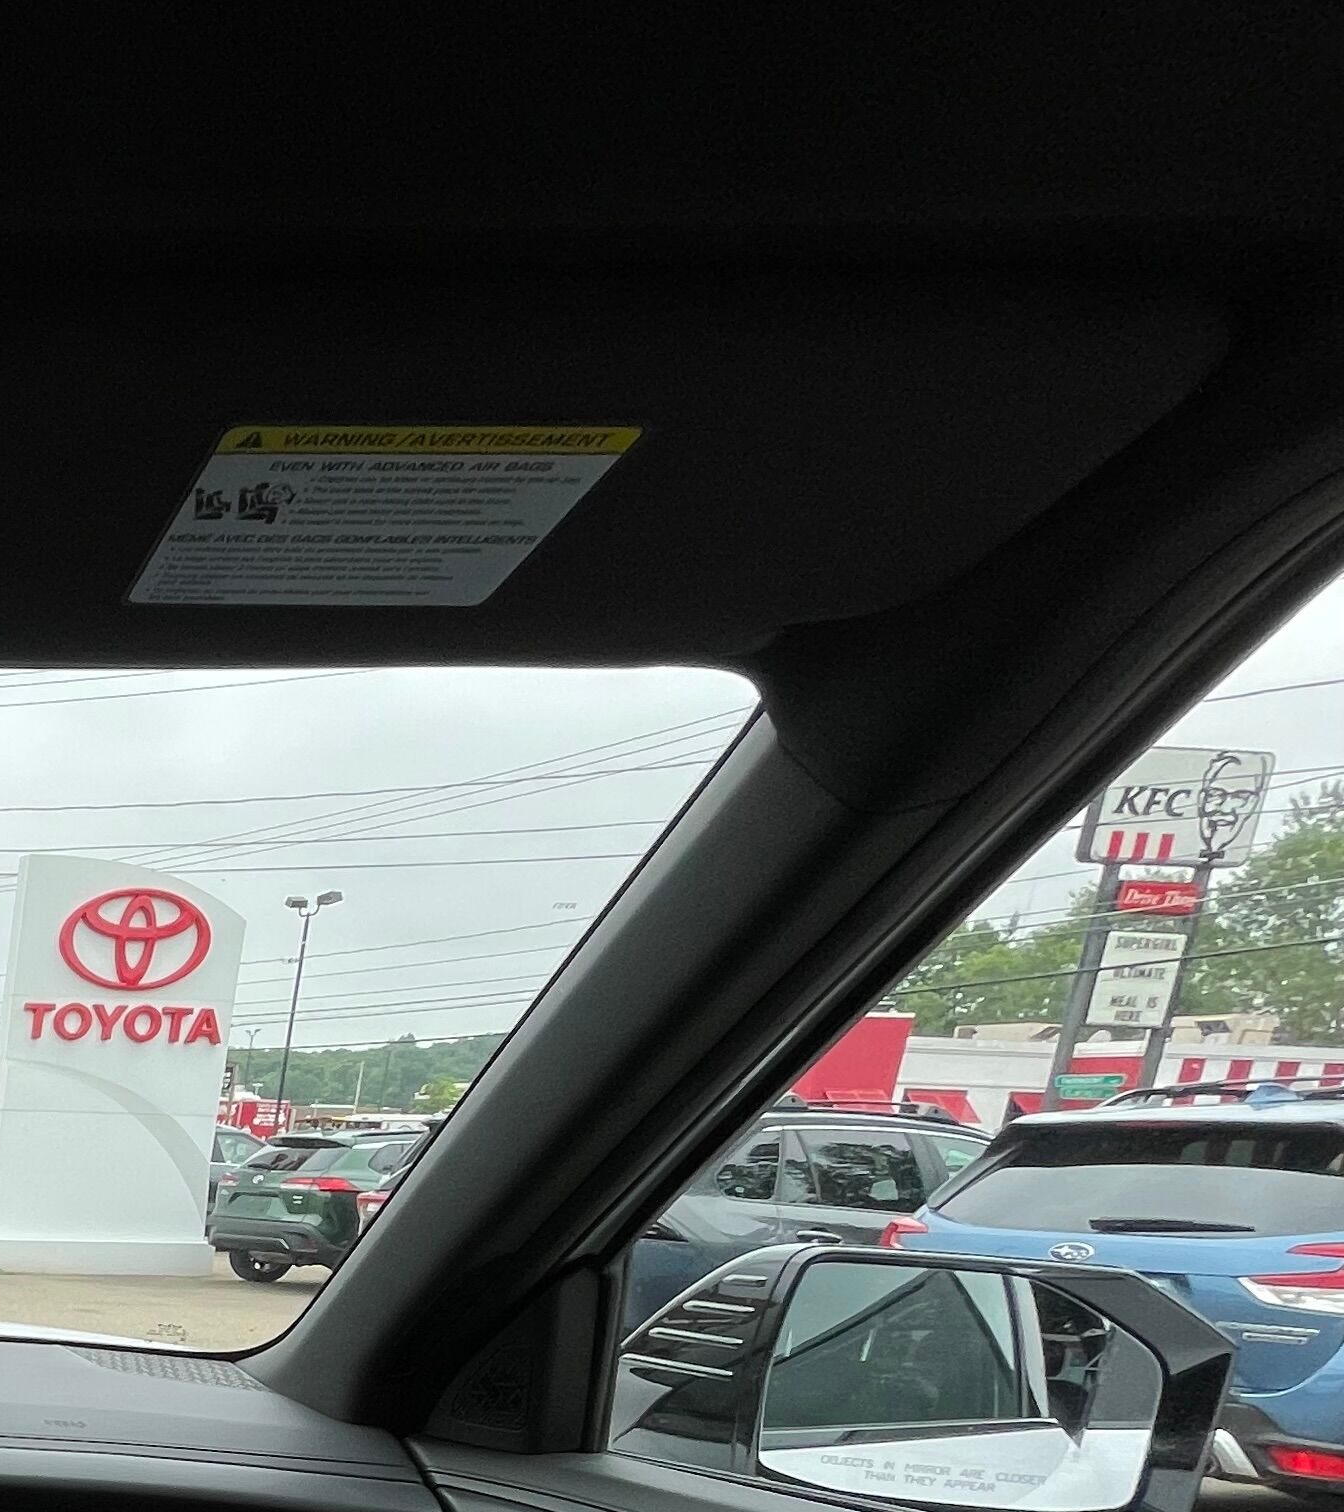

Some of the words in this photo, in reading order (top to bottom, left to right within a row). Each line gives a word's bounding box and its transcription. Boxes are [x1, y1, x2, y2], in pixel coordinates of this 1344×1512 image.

[283, 431, 394, 447] WARNING
[269, 461, 313, 473] EVEN
[320, 461, 363, 473] WITH
[367, 461, 464, 474] ADVANCED
[470, 461, 503, 473] AIR
[507, 461, 555, 474] BAGS
[1114, 785, 1194, 818] KFC
[1110, 995, 1138, 1008] MEAL
[1146, 996, 1160, 1009] IS
[23, 1001, 223, 1047] TOYOTA
[820, 1454, 875, 1469] OBJECTS
[883, 1461, 896, 1470] IN
[904, 1463, 951, 1476] MIRROR
[960, 1468, 986, 1480] ARE
[994, 1472, 1048, 1486] CLOSER
[864, 1470, 896, 1482] THAN
[904, 1474, 937, 1487] THEY
[944, 1478, 996, 1492] APPEAR
